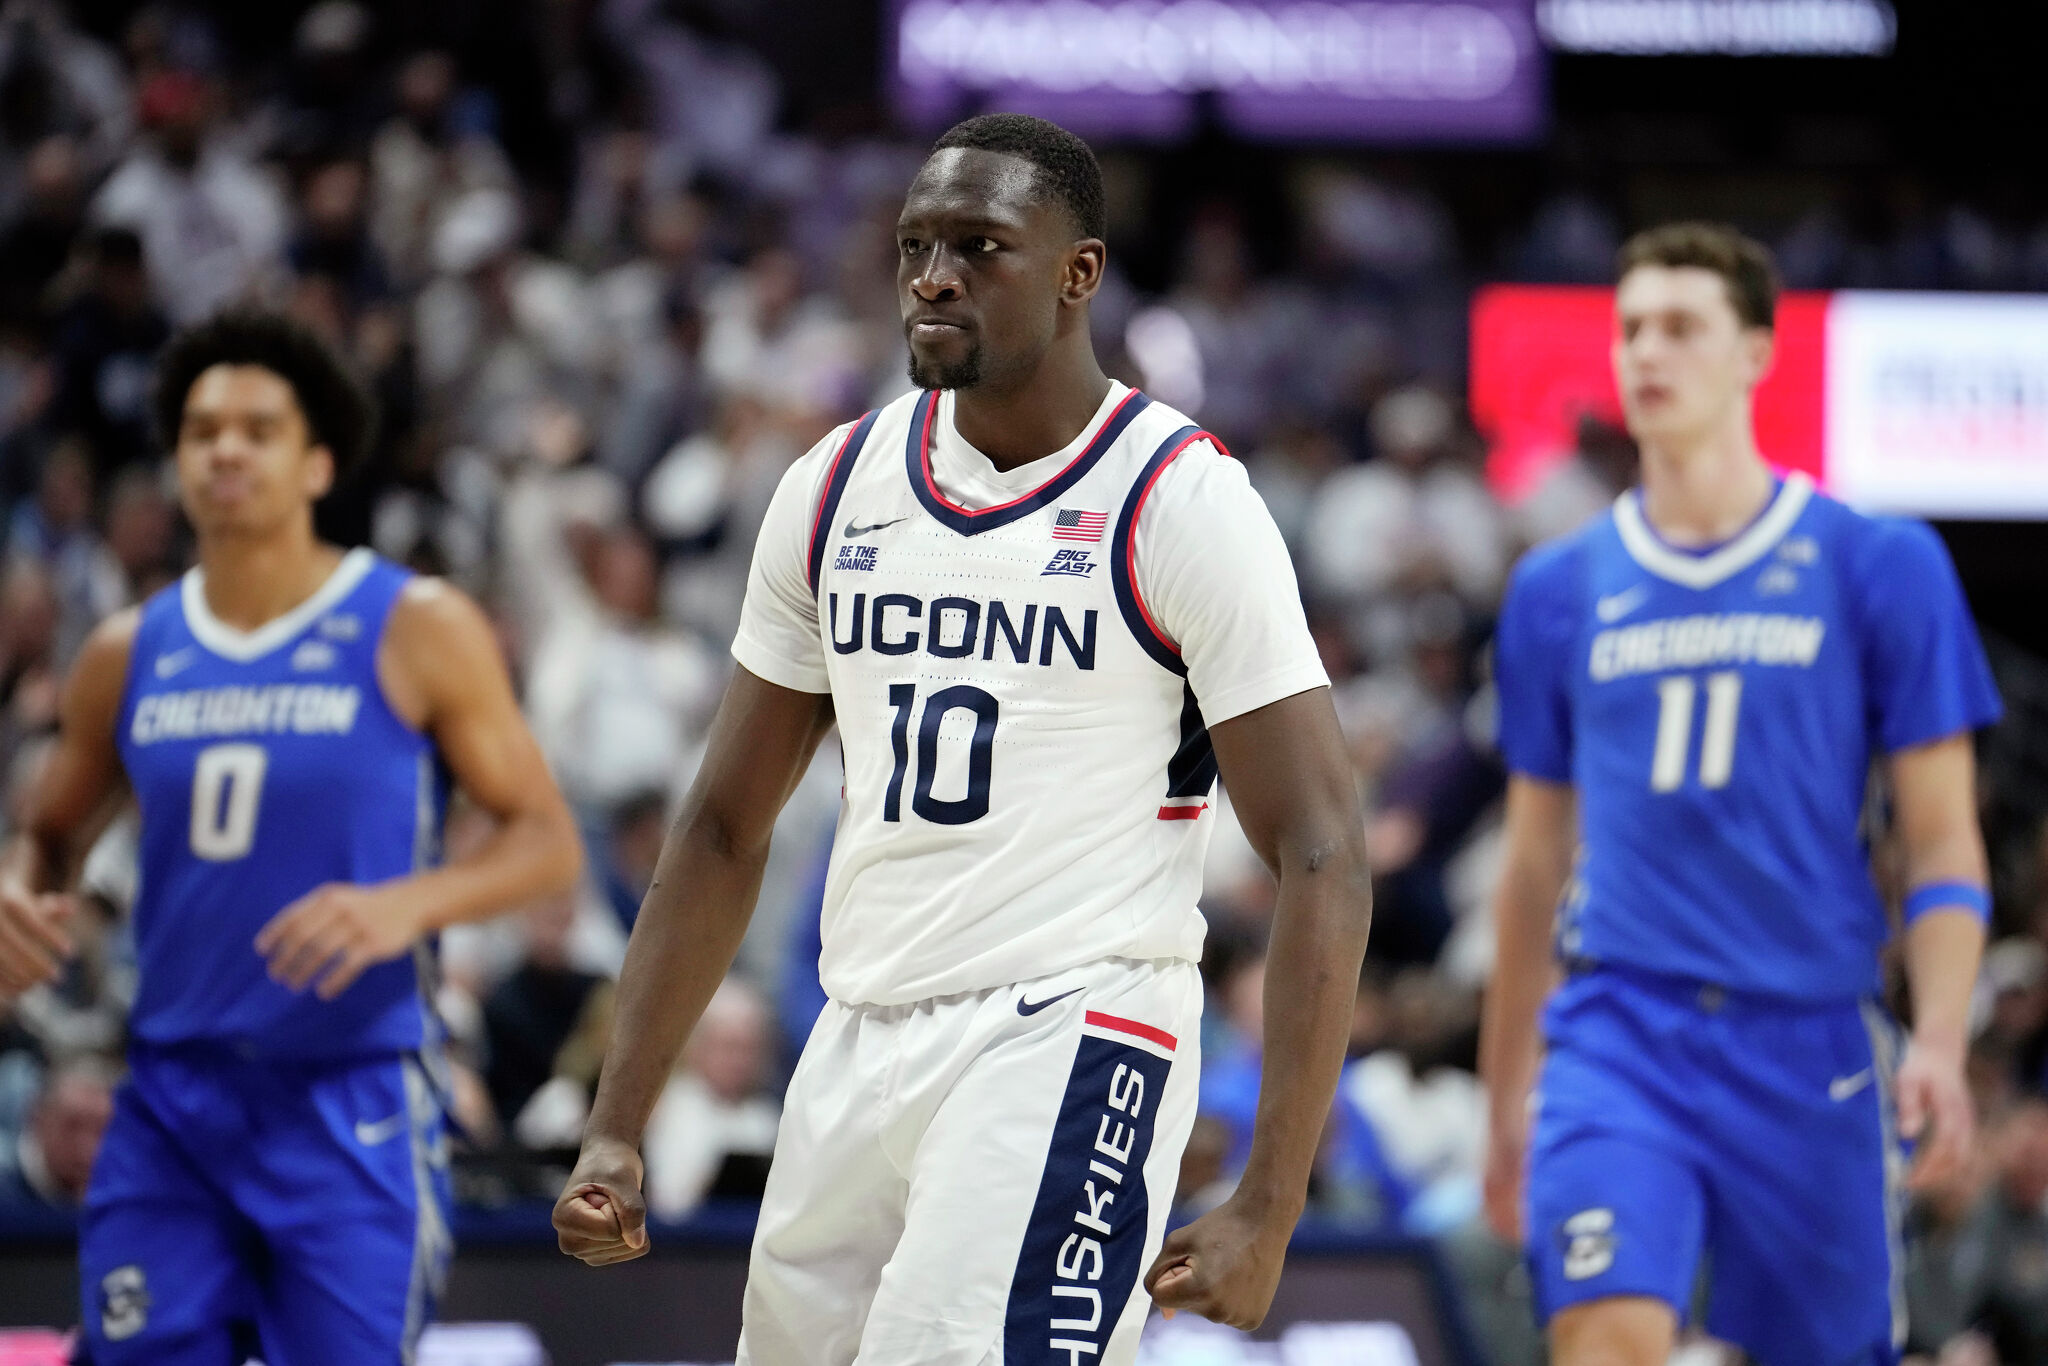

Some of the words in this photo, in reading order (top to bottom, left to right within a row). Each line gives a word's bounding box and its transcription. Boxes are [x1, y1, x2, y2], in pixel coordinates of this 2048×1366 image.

[834, 558, 877, 572] CHANGE
[839, 545, 854, 558] BE
[855, 545, 879, 559] THE
[1045, 560, 1097, 574] EAST
[1053, 549, 1091, 562] BIG
[829, 593, 1098, 671] UCONN
[884, 684, 999, 825] 10
[1651, 671, 1743, 793] 11
[190, 742, 268, 863] 0
